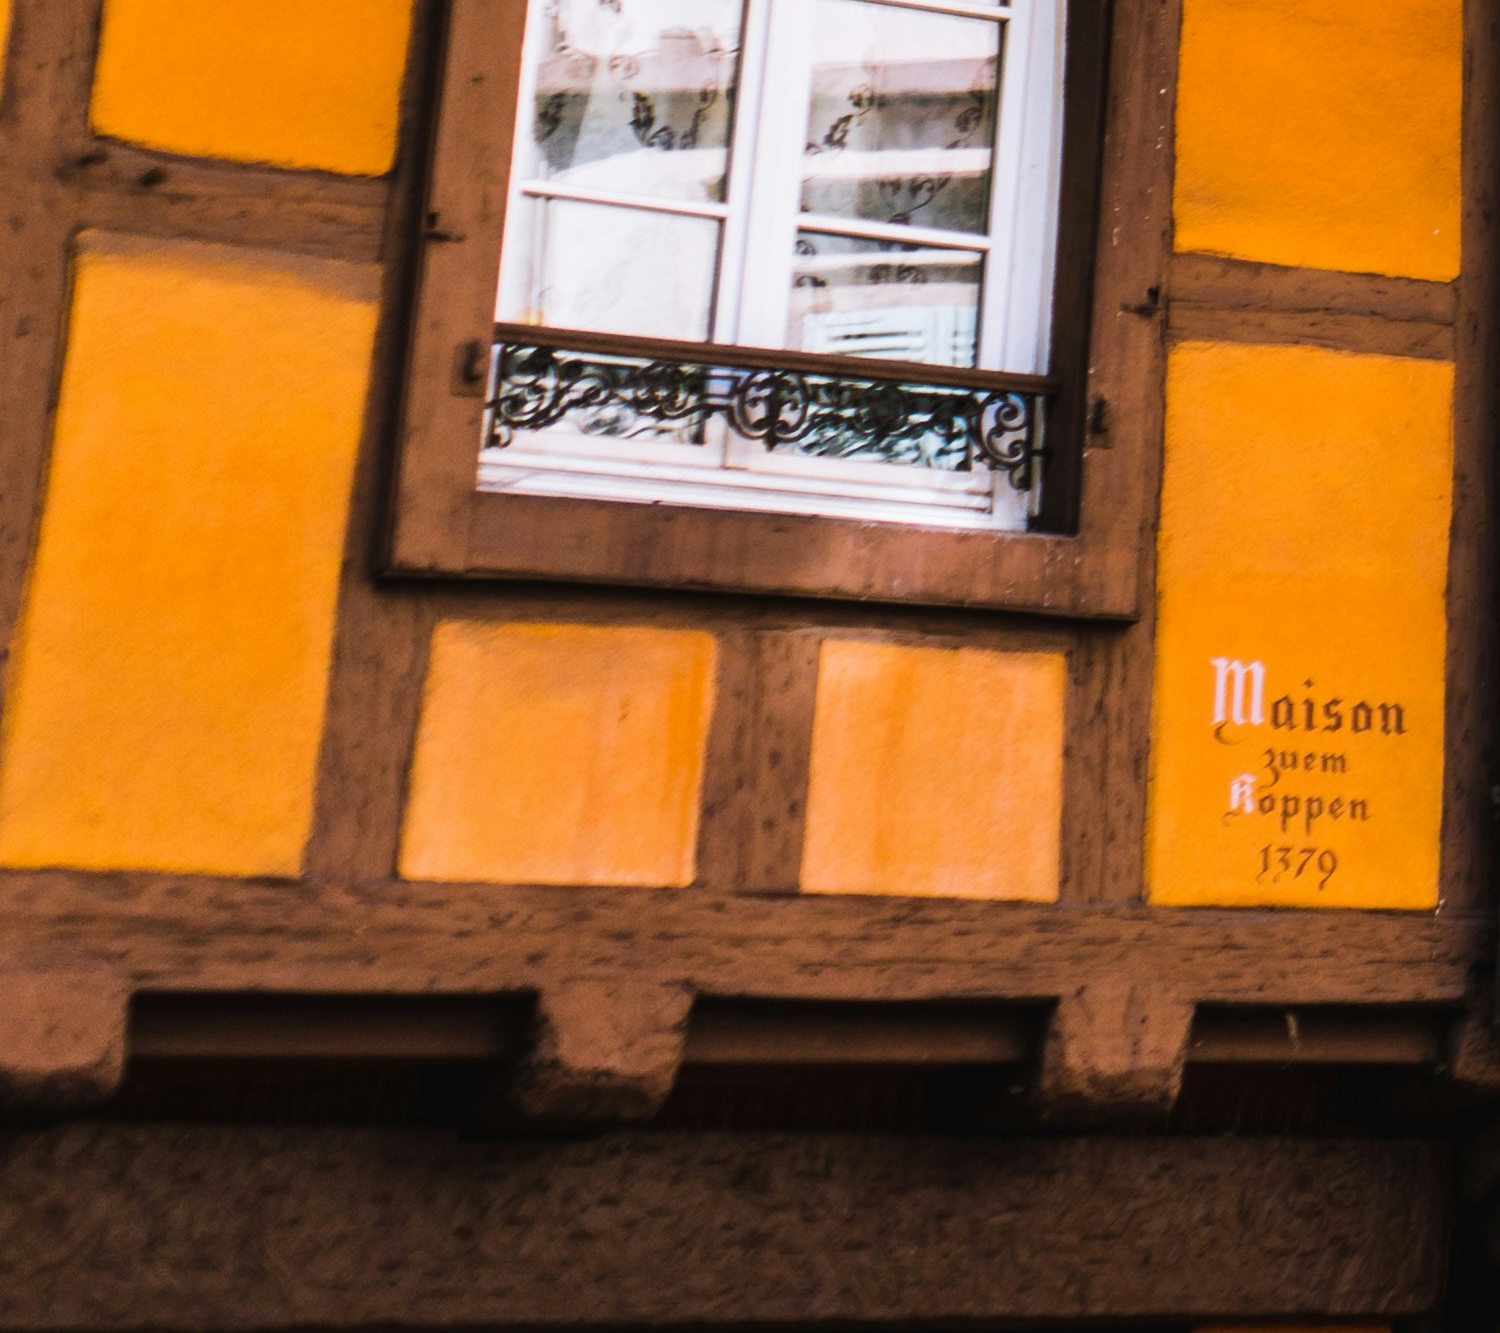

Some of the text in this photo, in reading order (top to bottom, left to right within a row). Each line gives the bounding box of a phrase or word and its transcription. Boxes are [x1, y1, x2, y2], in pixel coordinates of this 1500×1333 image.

[1209, 657, 1407, 745] Maison
[1259, 747, 1348, 791] zuem
[1256, 843, 1339, 891] 1379
